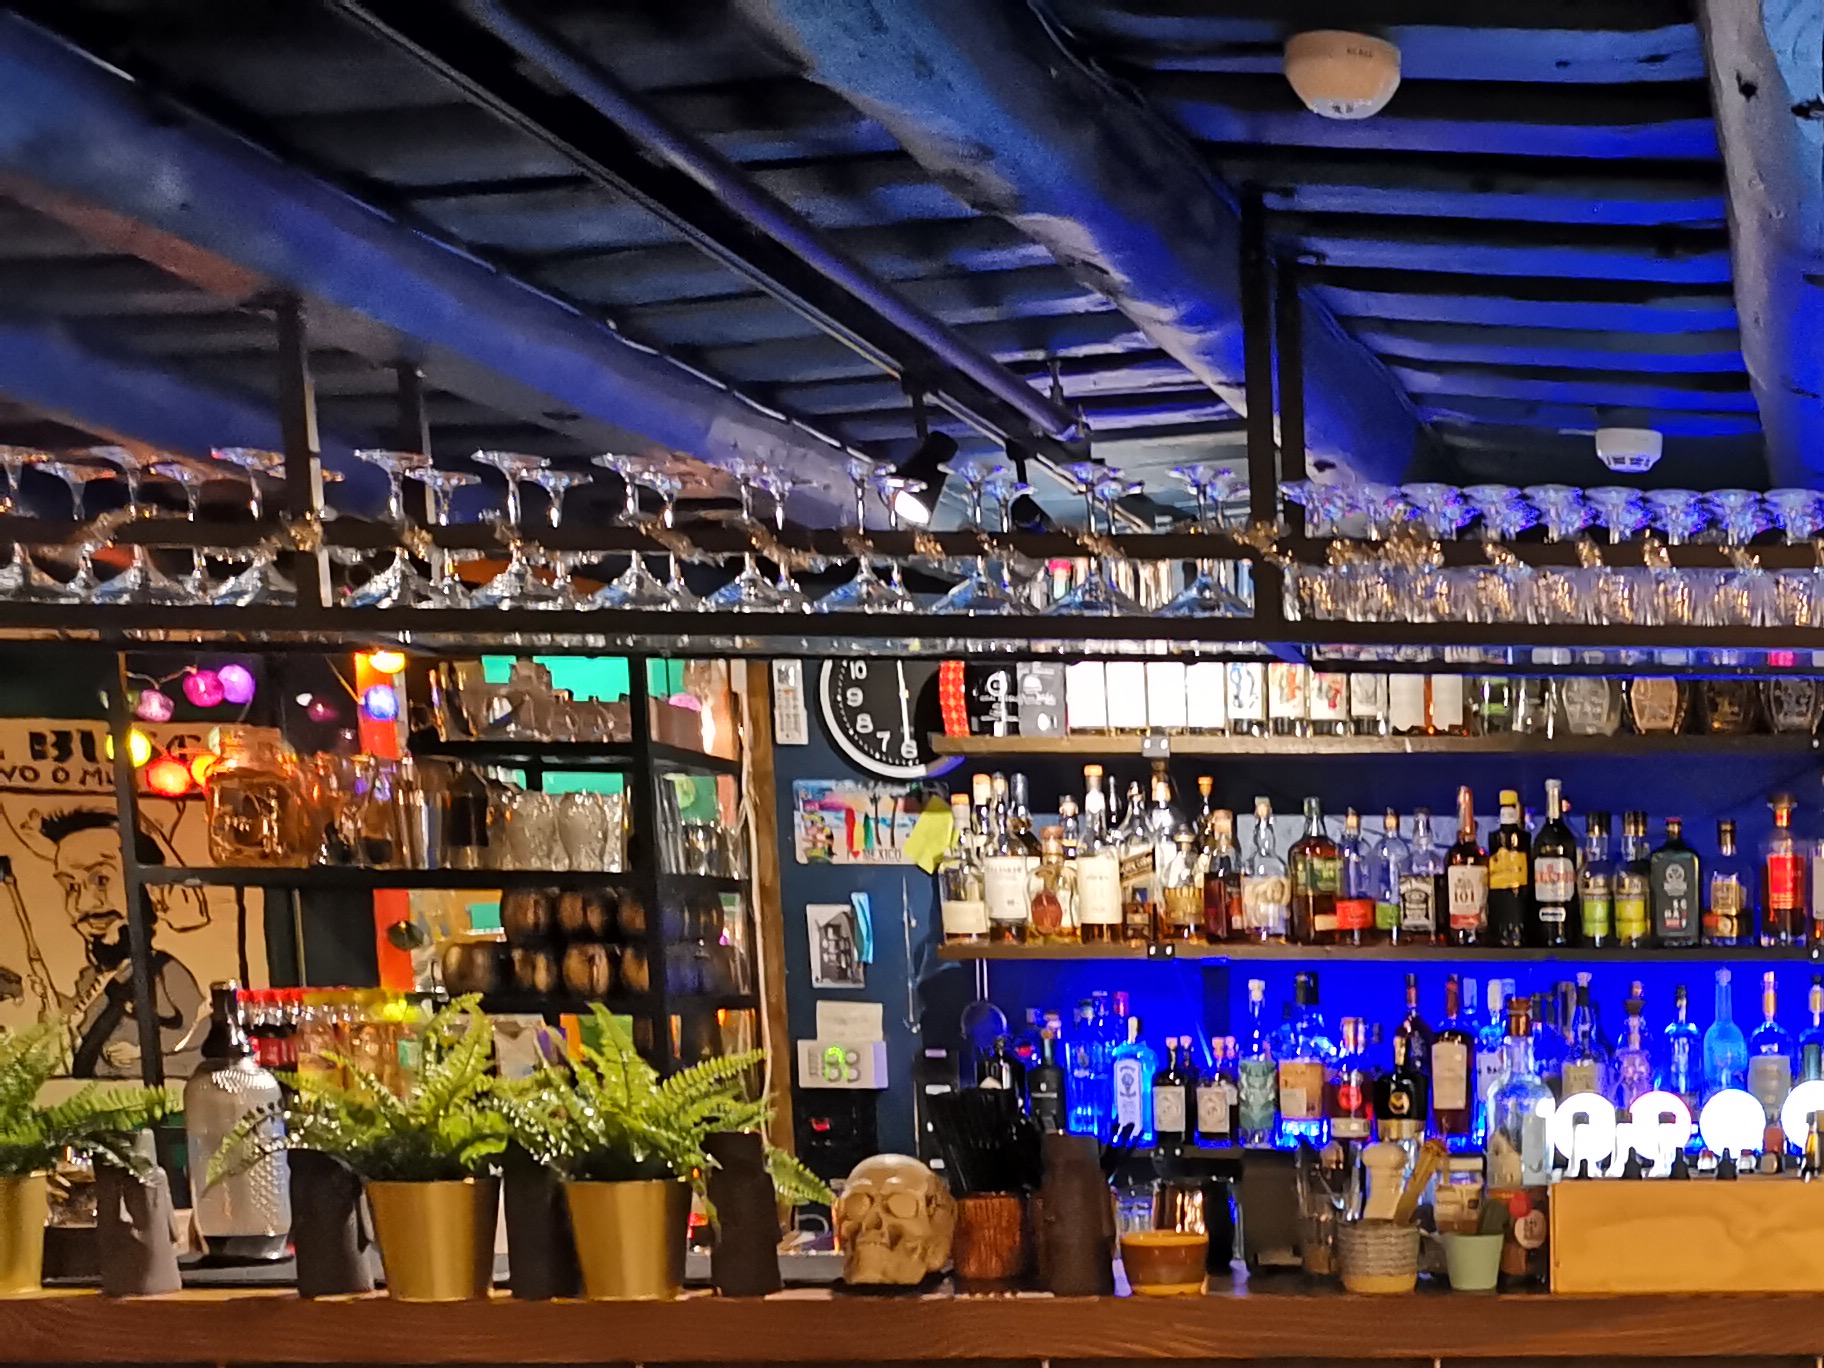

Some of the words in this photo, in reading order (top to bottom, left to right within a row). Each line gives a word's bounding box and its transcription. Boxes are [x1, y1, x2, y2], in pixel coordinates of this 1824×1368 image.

[850, 660, 867, 680] 10
[846, 687, 864, 707] 9
[856, 713, 874, 734] 8
[876, 731, 891, 752] 7
[901, 739, 918, 759] 6
[863, 848, 902, 862] MEXICO
[1454, 889, 1475, 903] 101
